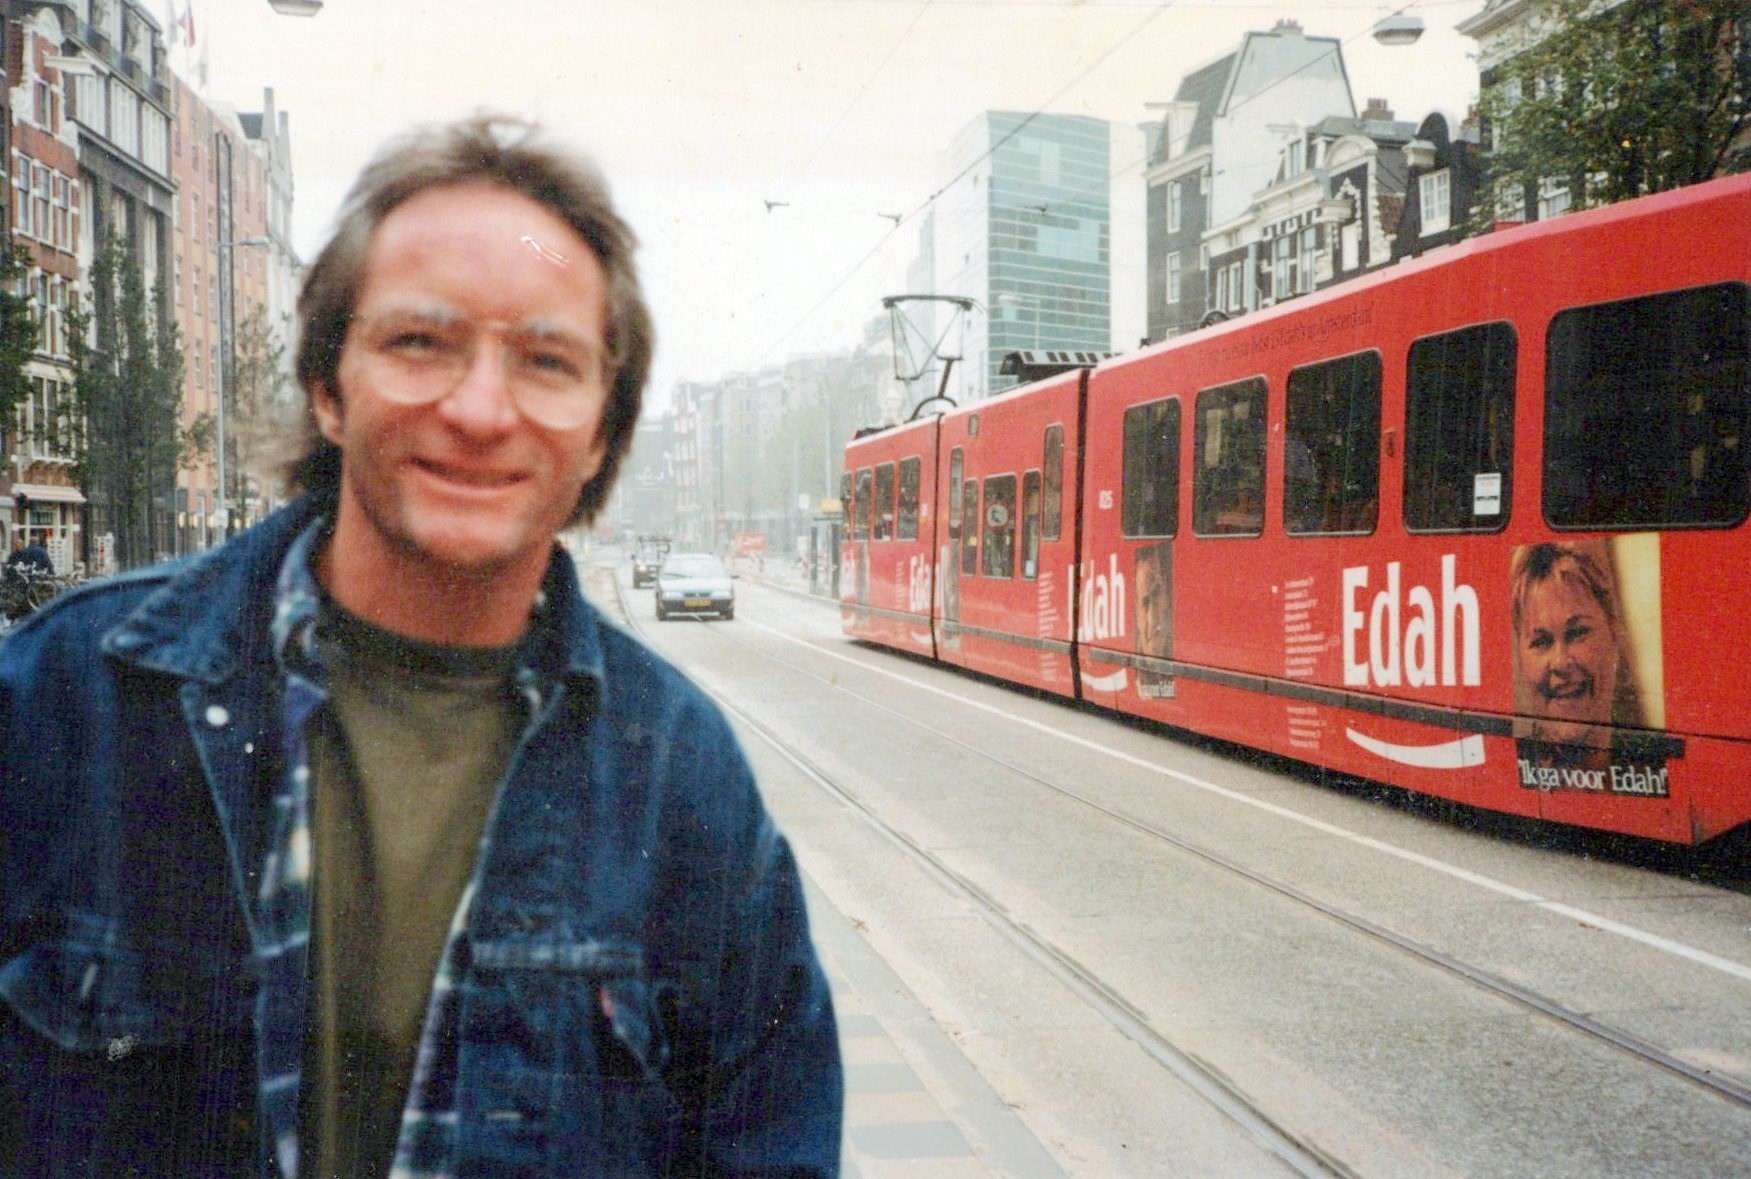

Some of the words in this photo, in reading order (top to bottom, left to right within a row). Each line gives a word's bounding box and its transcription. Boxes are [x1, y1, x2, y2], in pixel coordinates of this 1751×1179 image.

[1342, 554, 1482, 688] Edah
[1538, 766, 1560, 791] ga
[1561, 768, 1607, 790] voor
